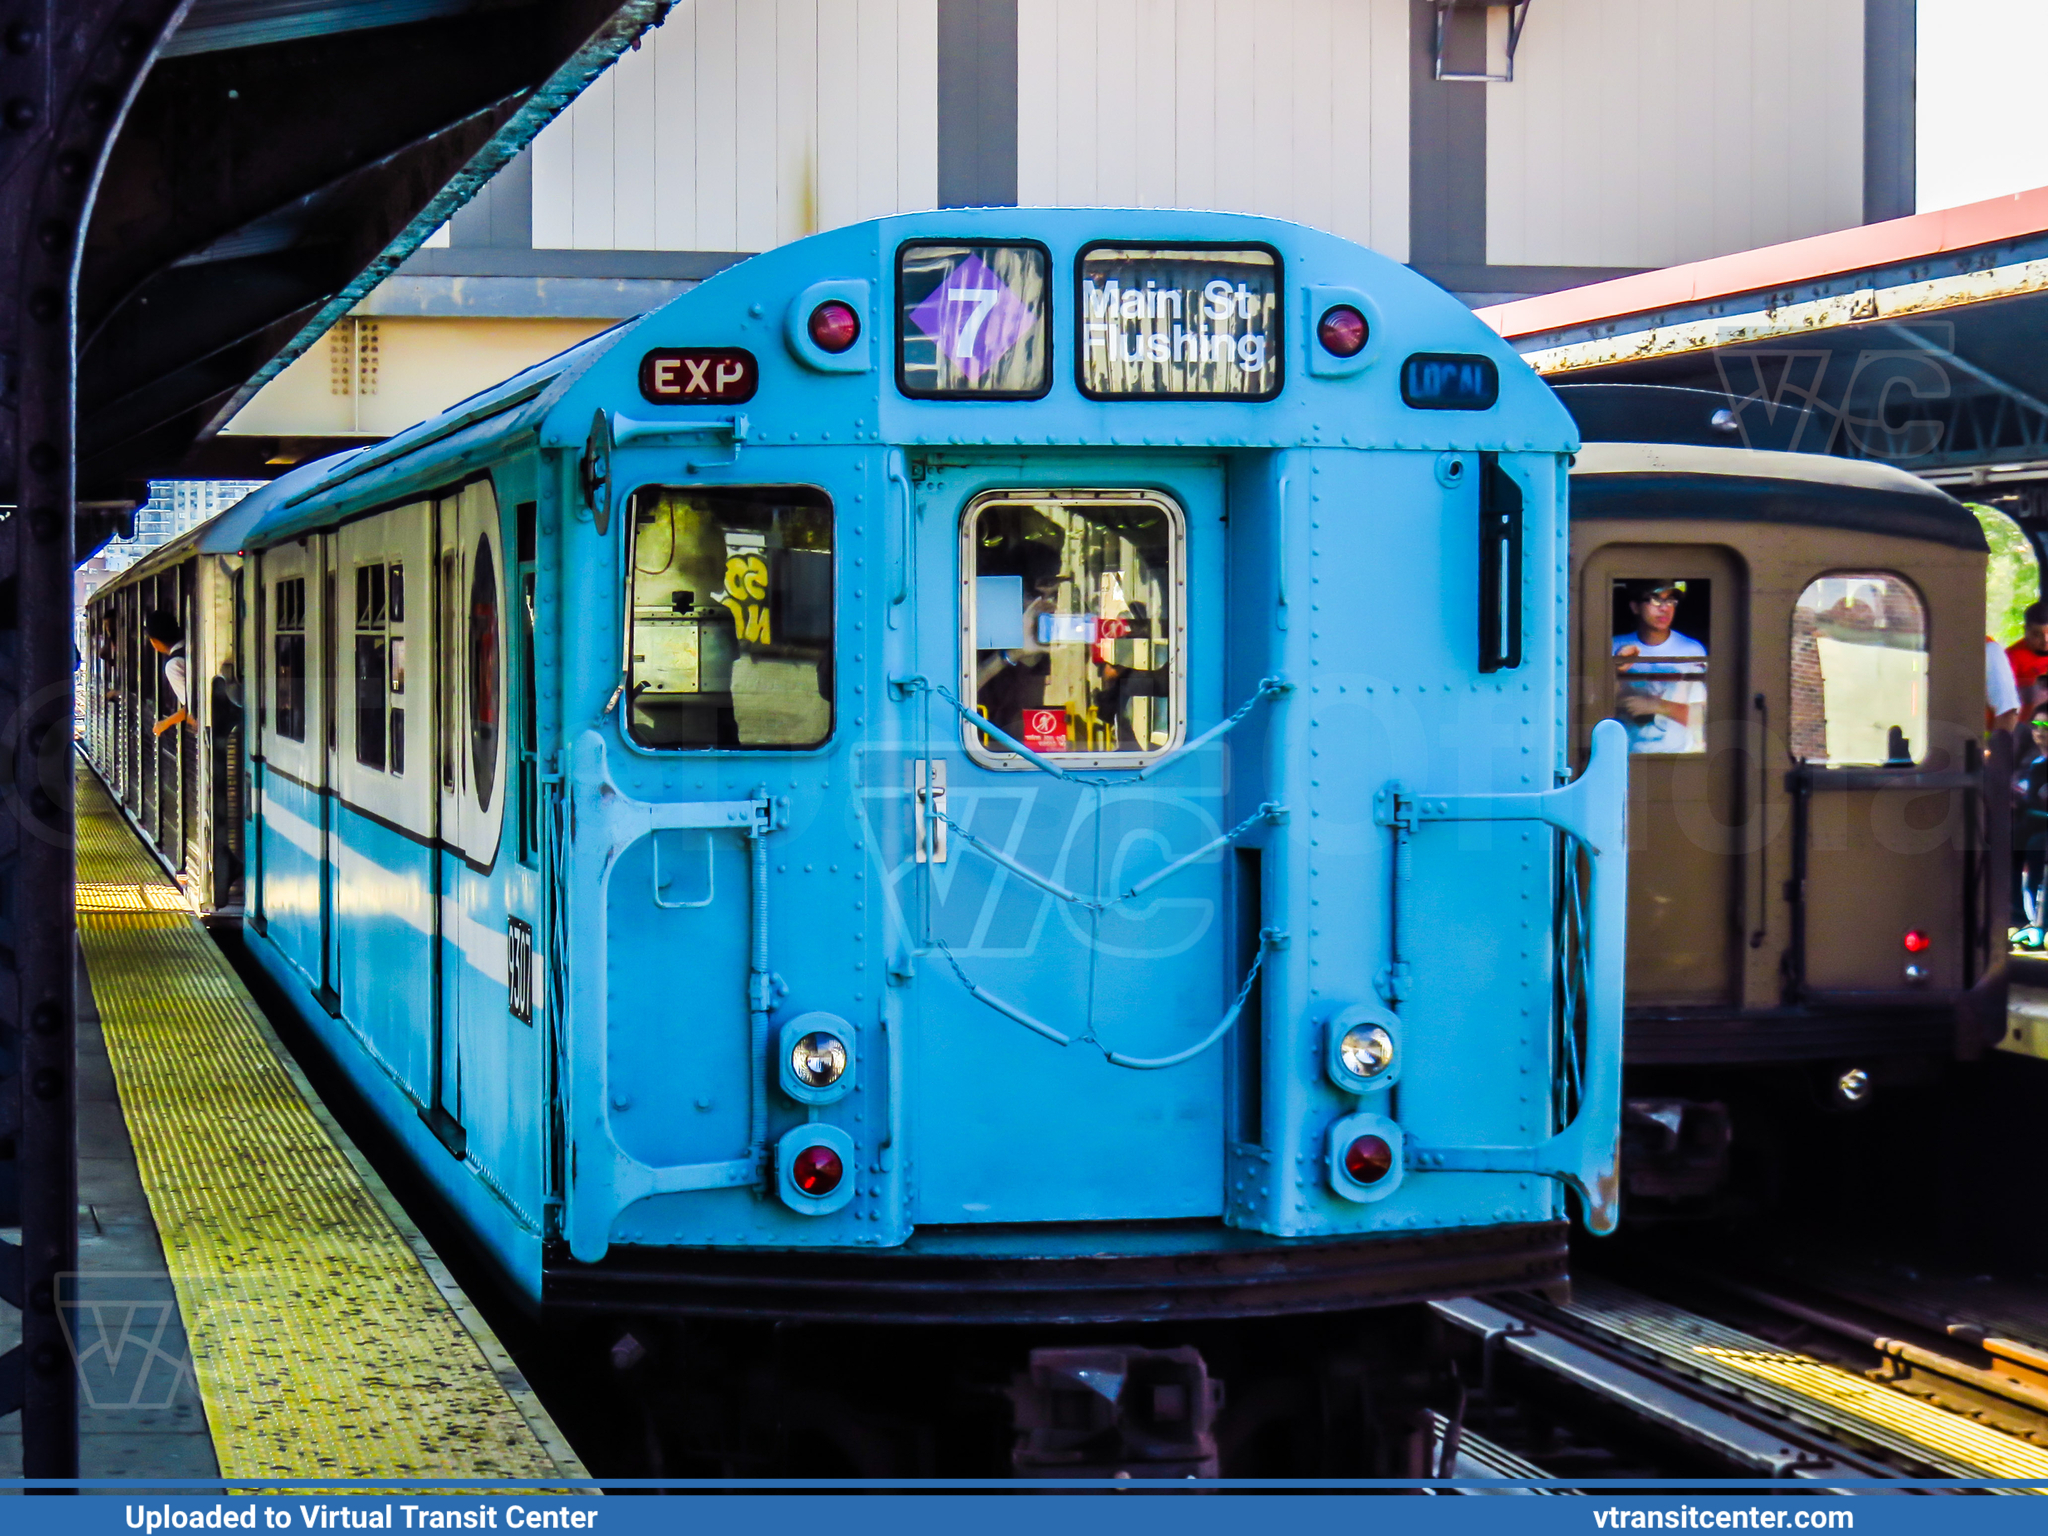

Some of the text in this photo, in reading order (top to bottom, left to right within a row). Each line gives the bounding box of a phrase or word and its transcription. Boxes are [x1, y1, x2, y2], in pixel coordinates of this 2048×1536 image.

[947, 288, 998, 358] 7
[1083, 279, 1252, 320] Main St
[1084, 323, 1266, 372] Flushing
[655, 359, 744, 393] EXP
[508, 925, 531, 1016] 9307
